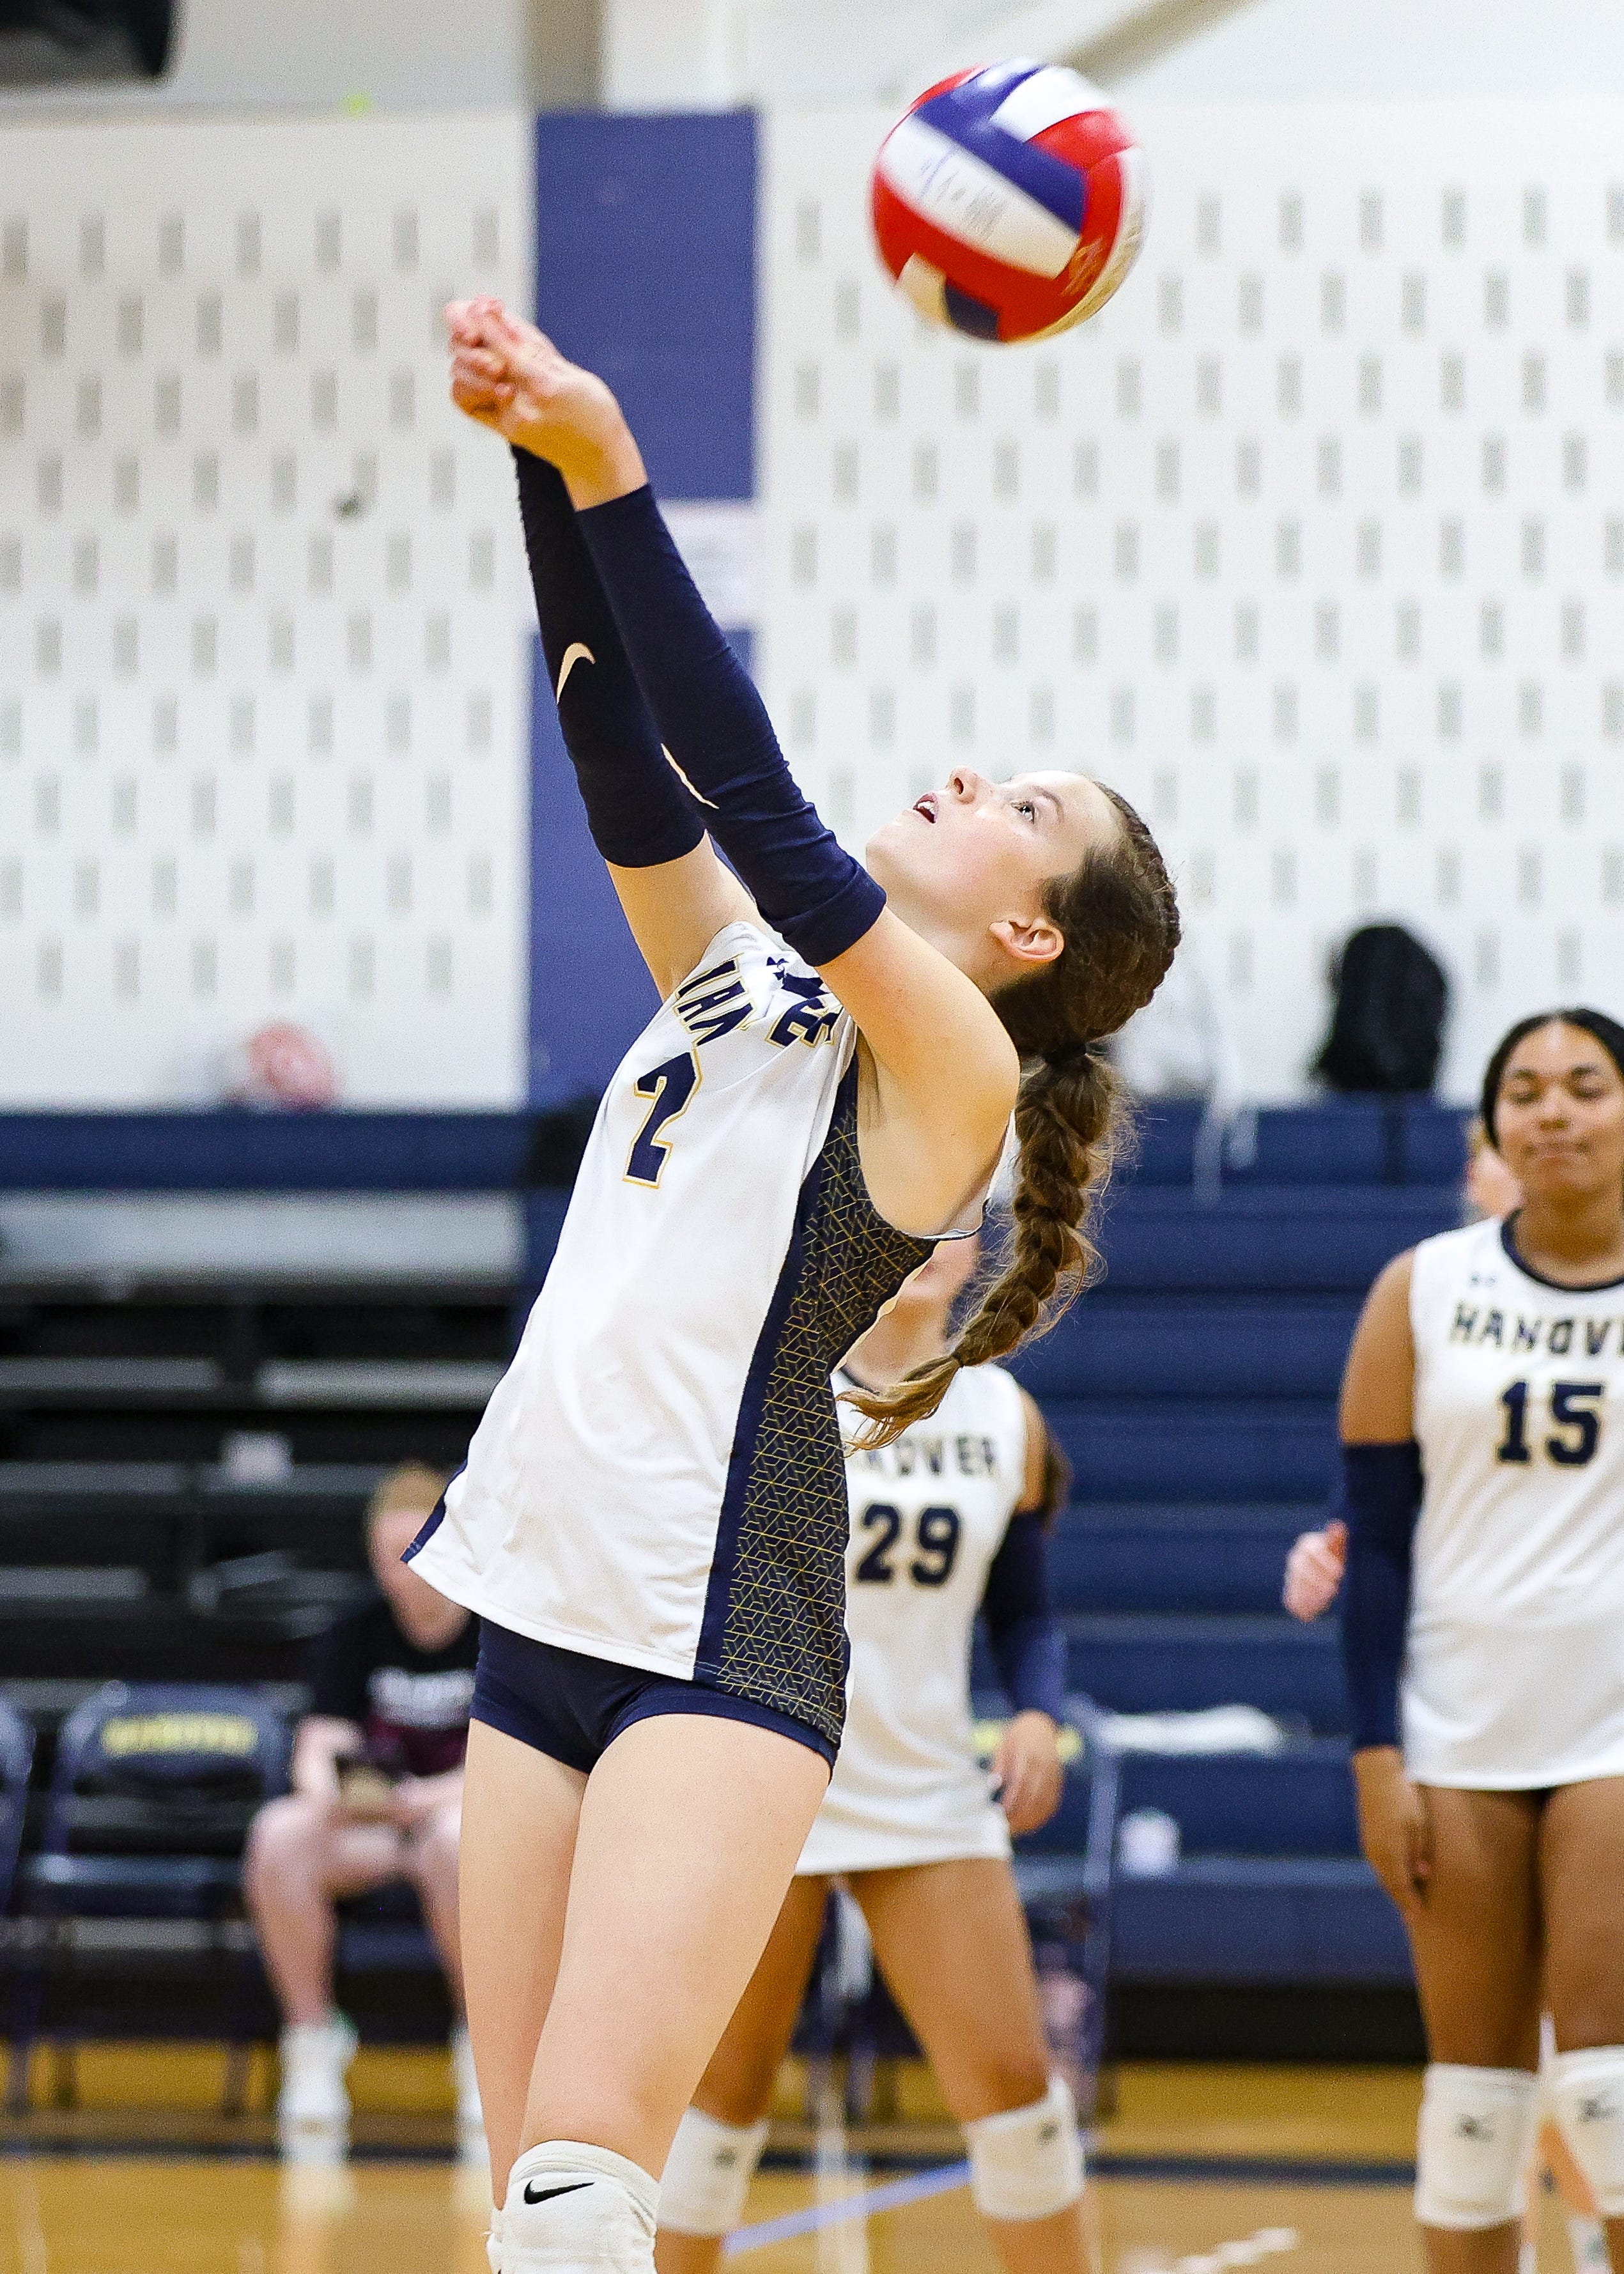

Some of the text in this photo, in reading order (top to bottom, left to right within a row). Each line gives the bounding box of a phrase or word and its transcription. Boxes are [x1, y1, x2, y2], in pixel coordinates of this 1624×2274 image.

[623, 1048, 702, 1189] 2
[1448, 1301, 1624, 1357] HANOV
[1496, 1379, 1604, 1465] 15
[857, 1501, 963, 1586] 29
